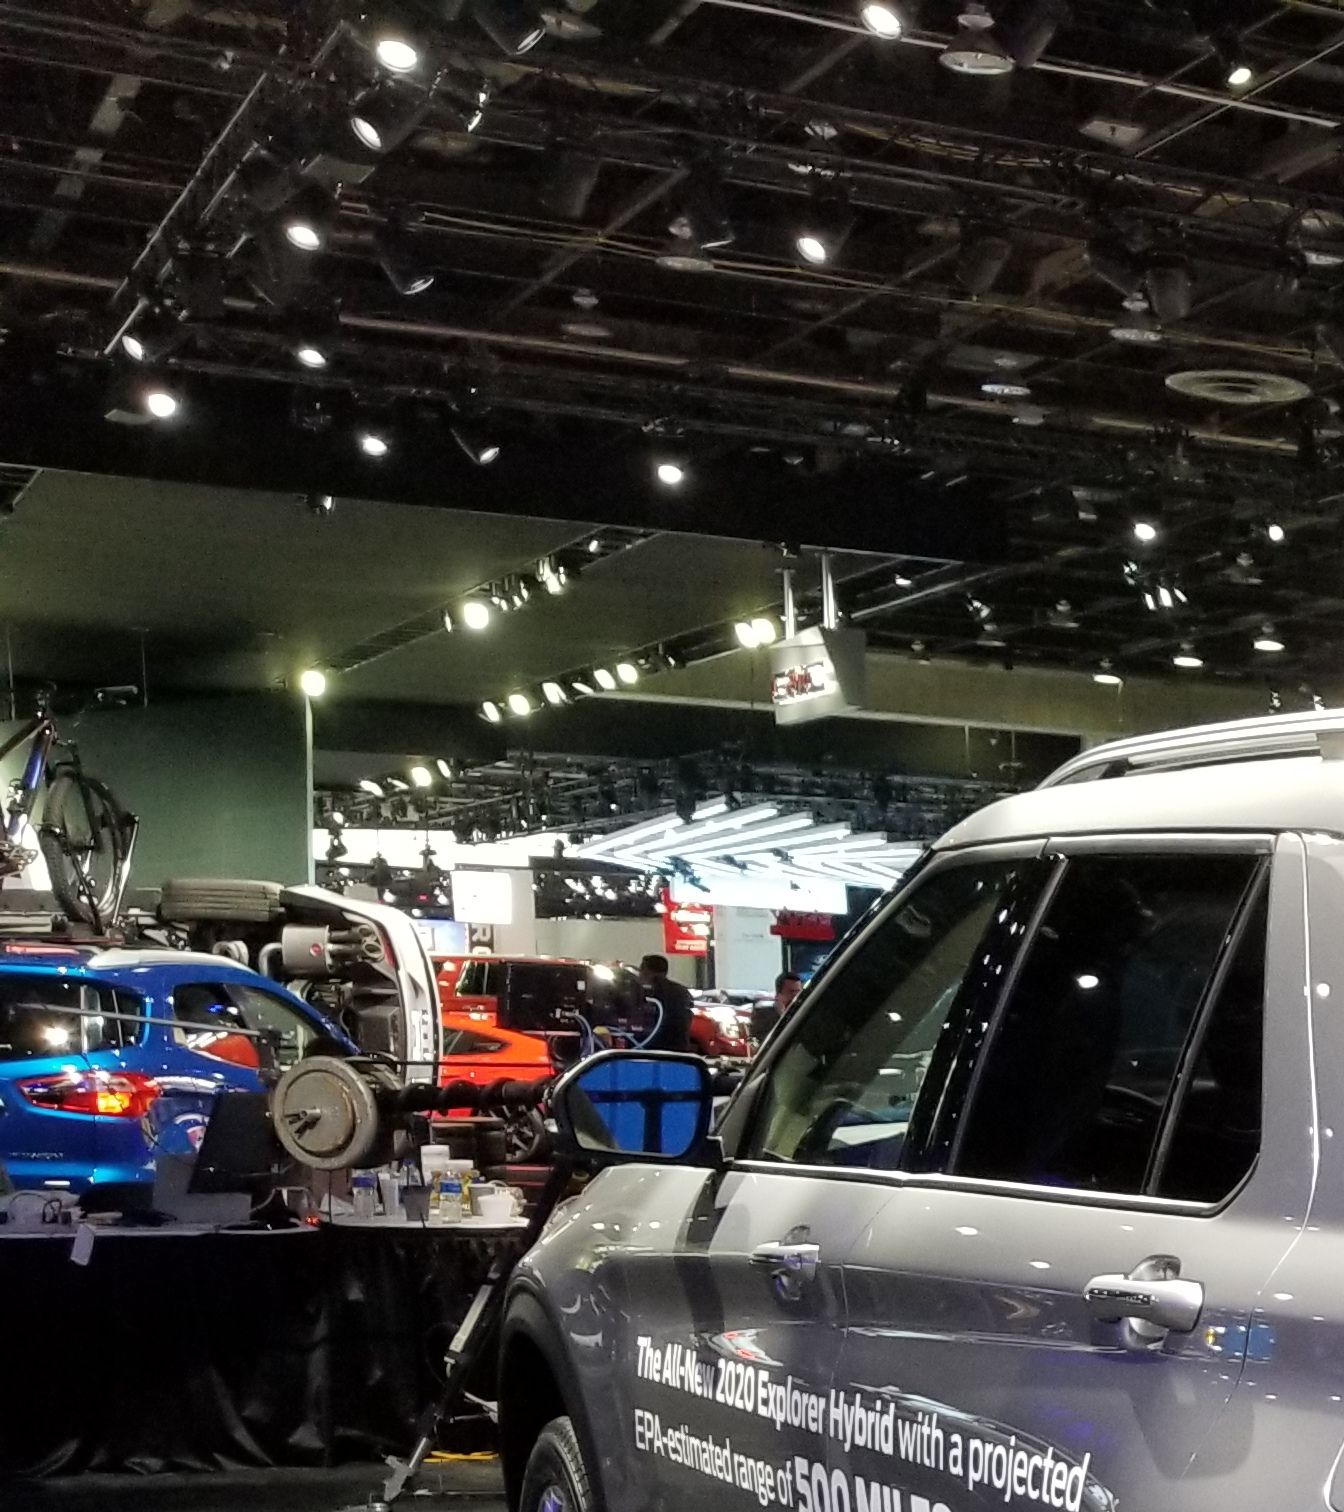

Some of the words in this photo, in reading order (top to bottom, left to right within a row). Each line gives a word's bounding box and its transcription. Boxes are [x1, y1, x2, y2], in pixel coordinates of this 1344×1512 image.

[633, 1408, 732, 1485] EPA-estimated
[733, 1450, 776, 1508] range
[776, 1459, 794, 1509] of
[637, 1335, 661, 1383] The
[661, 1342, 716, 1401] All-New
[715, 1357, 756, 1414] 2020
[756, 1368, 826, 1435] Explorer
[828, 1387, 895, 1456] Hybrid
[897, 1411, 944, 1472] with
[948, 1432, 964, 1478] a
